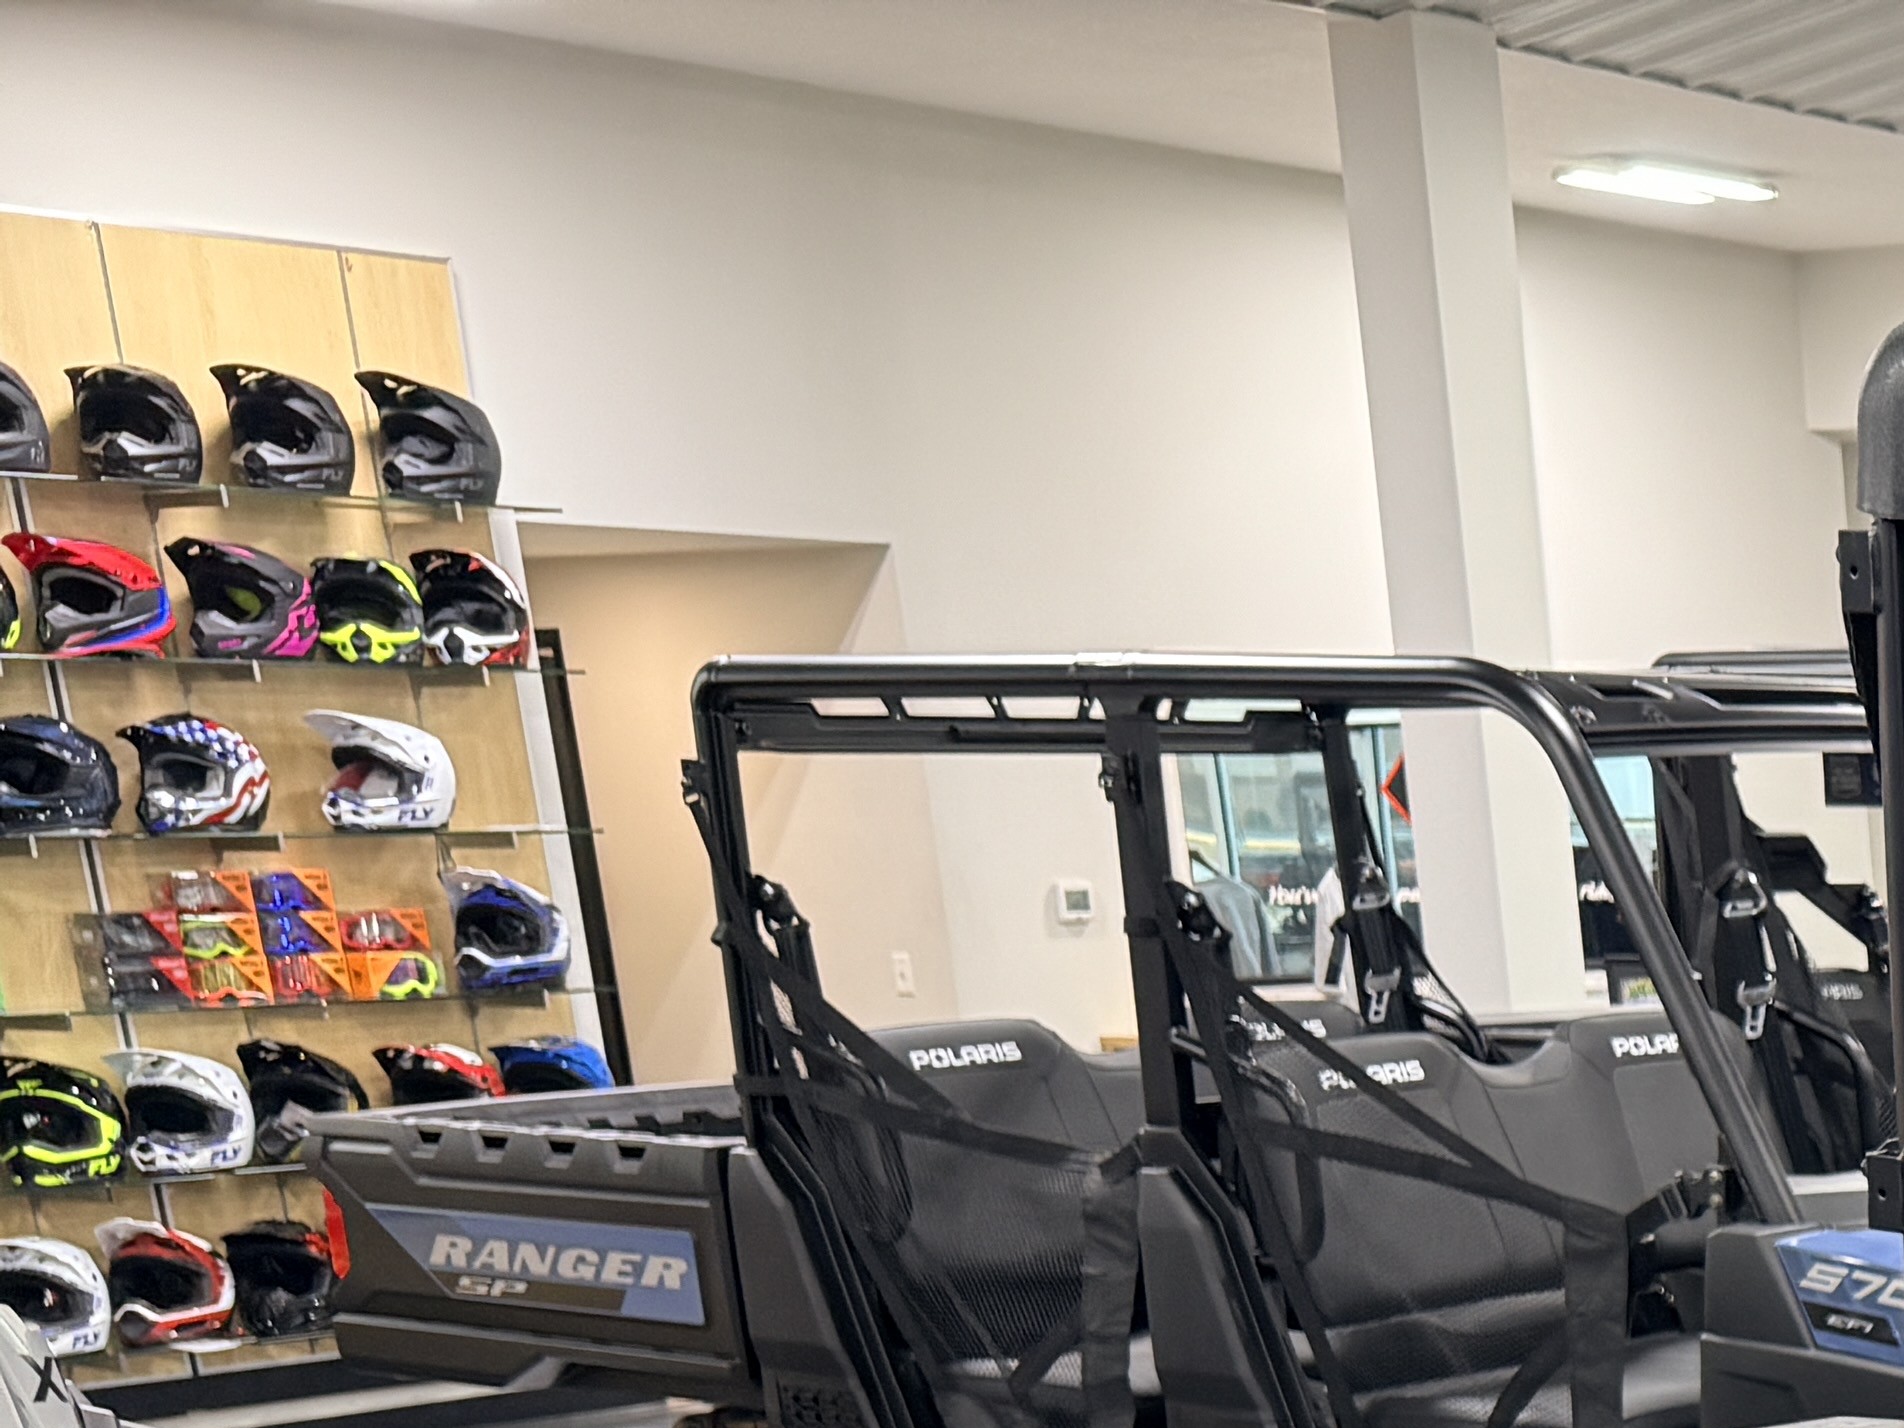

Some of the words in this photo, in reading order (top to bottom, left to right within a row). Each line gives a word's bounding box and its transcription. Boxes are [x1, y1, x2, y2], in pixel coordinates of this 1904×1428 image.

[398, 806, 434, 823] FLY
[909, 1041, 1022, 1071] POLARIS
[1318, 1059, 1426, 1092] PARIS
[88, 1153, 121, 1179] FLY
[211, 1146, 242, 1166] FLY
[428, 1233, 688, 1290] RANGER
[455, 1275, 528, 1297] SP
[72, 1330, 101, 1350] FLY
